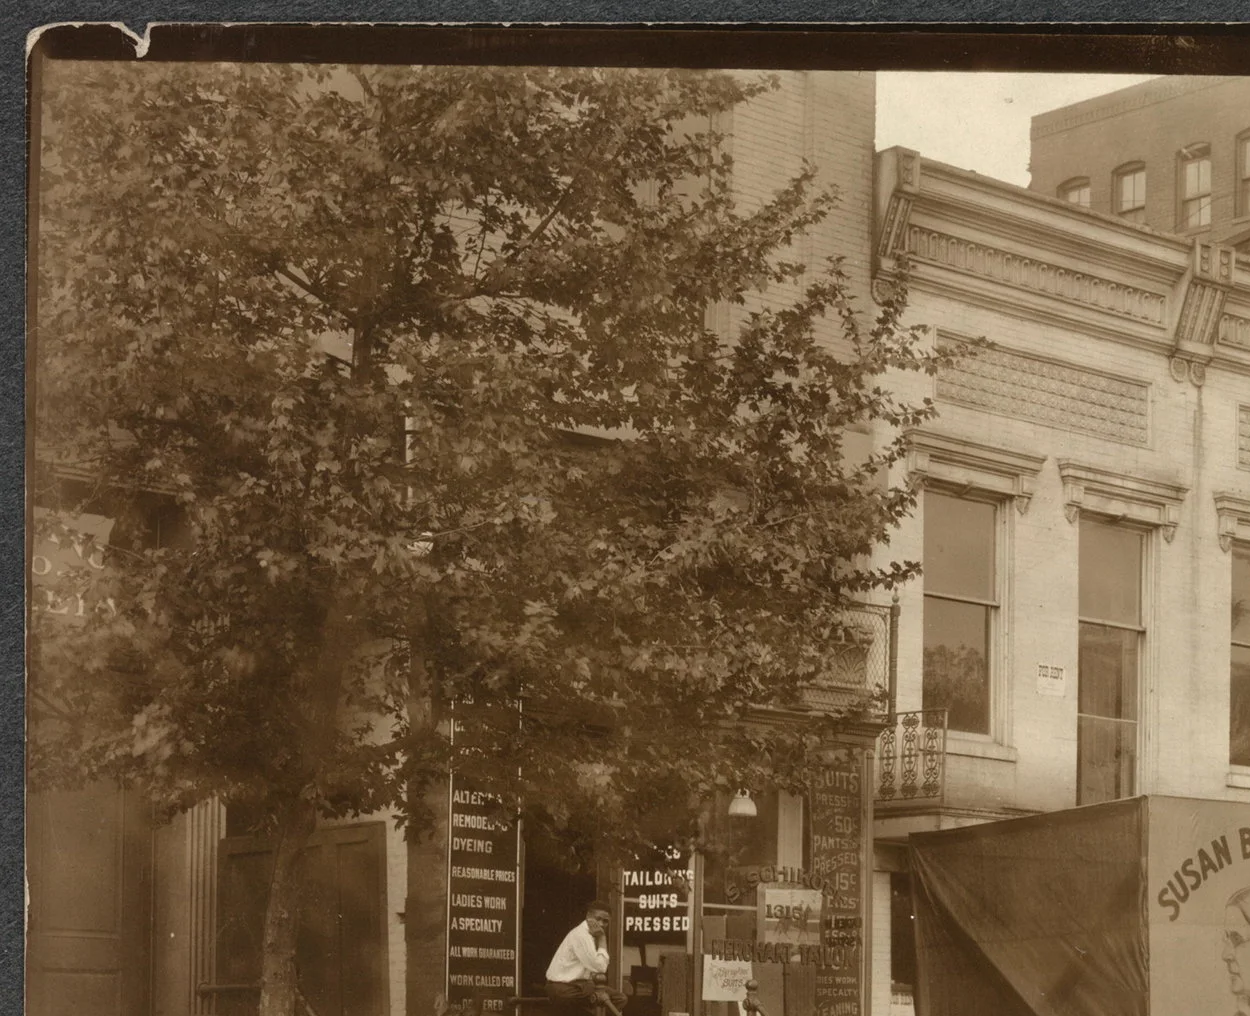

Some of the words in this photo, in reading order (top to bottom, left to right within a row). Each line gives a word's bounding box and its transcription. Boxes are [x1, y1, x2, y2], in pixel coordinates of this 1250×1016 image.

[815, 771, 859, 793] SUITS
[453, 837, 493, 853] DYEING
[813, 835, 849, 853] PANTS
[813, 852, 858, 874] PRESSED
[452, 866, 494, 881] REASONABLE
[495, 871, 515, 882] PRICES
[1157, 834, 1232, 921] SUSAN
[452, 893, 482, 908] LADIES
[484, 897, 507, 910] WORK
[639, 893, 678, 909] SUITS
[451, 917, 457, 930] A
[459, 918, 503, 933] SPECIALTY
[626, 916, 690, 931] PRESSED
[451, 946, 461, 957] ALL
[462, 947, 478, 958] WORK
[479, 947, 515, 960] GUARANTEED
[712, 939, 793, 964] MERCHANT
[450, 974, 474, 987] WORK
[475, 975, 500, 987] CALLED
[502, 976, 514, 988] FOR
